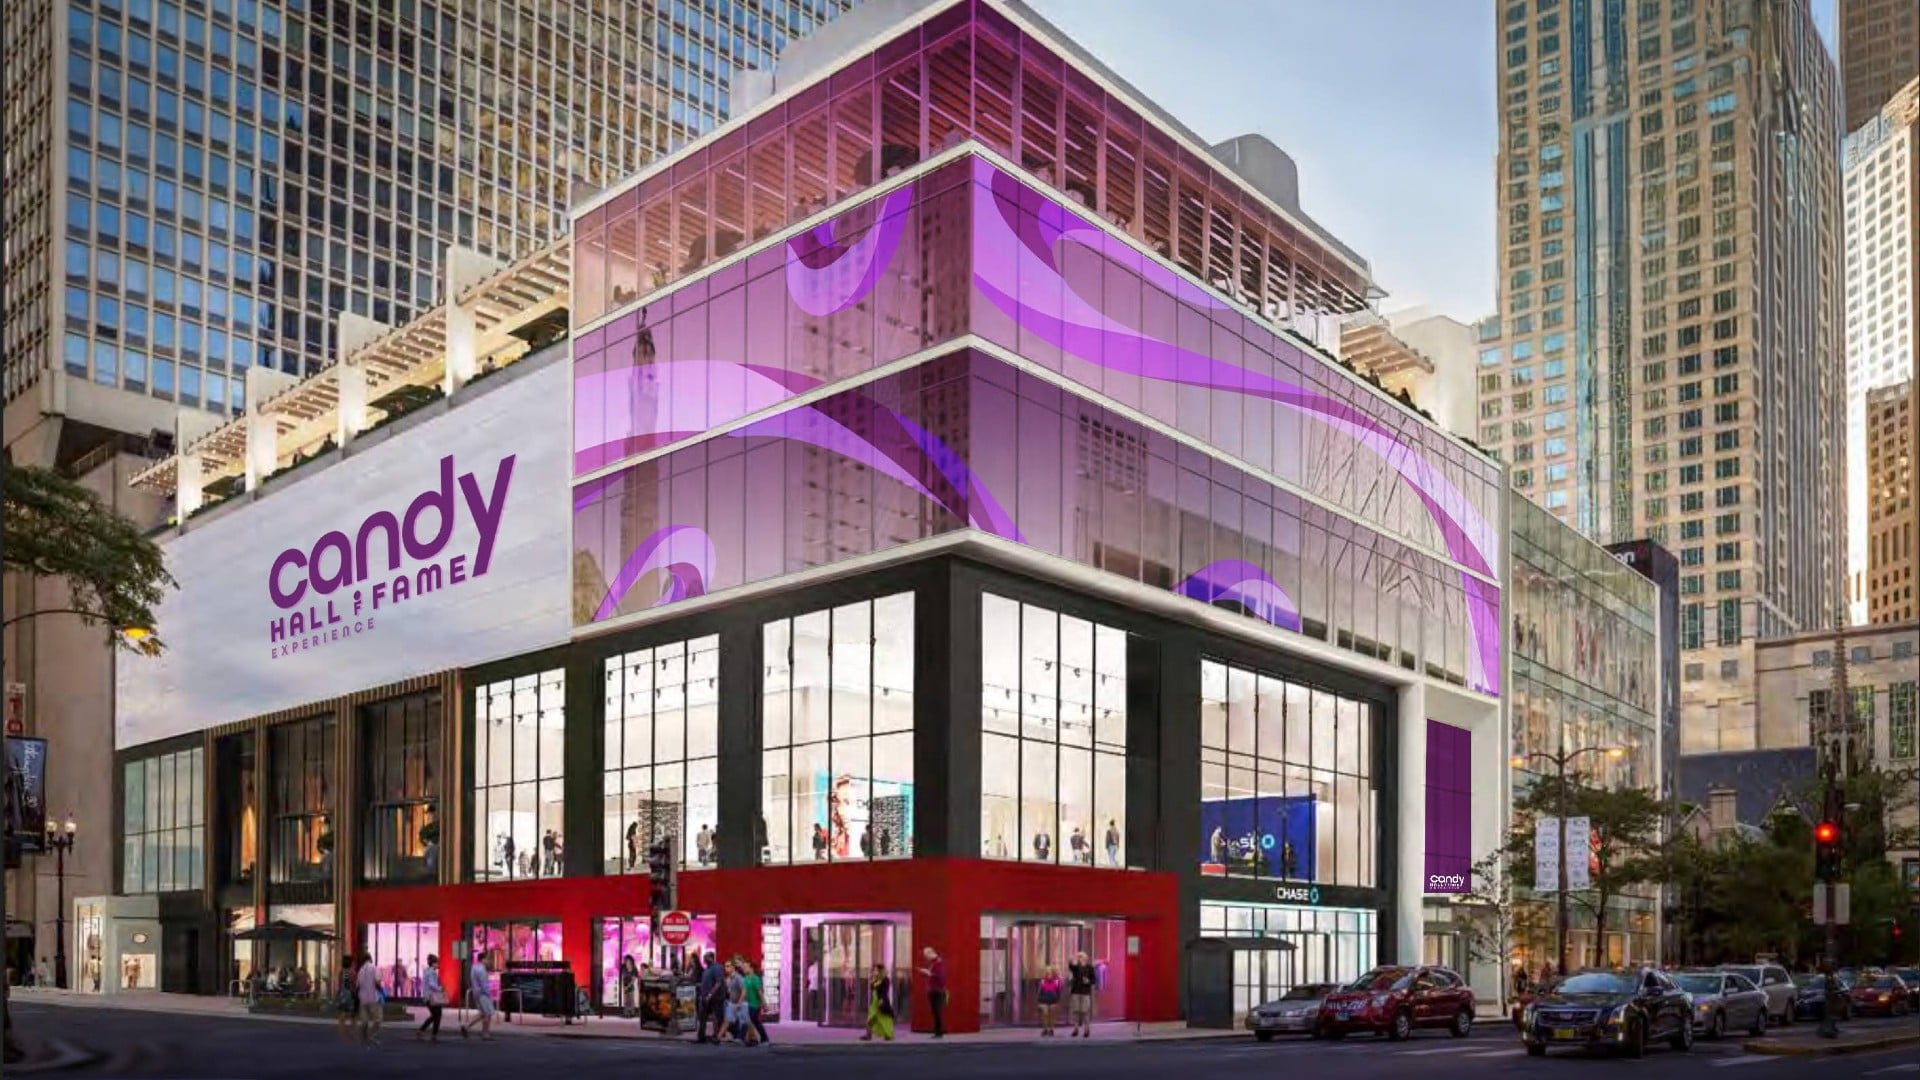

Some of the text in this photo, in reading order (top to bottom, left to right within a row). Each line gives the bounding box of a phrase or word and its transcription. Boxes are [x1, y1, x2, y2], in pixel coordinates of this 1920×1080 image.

[269, 454, 516, 609] candy
[271, 601, 341, 642] HALL
[372, 554, 466, 609] FAME
[271, 618, 375, 659] EXPERIENCE
[1276, 886, 1309, 900] CHASE
[1430, 873, 1464, 887] candy
